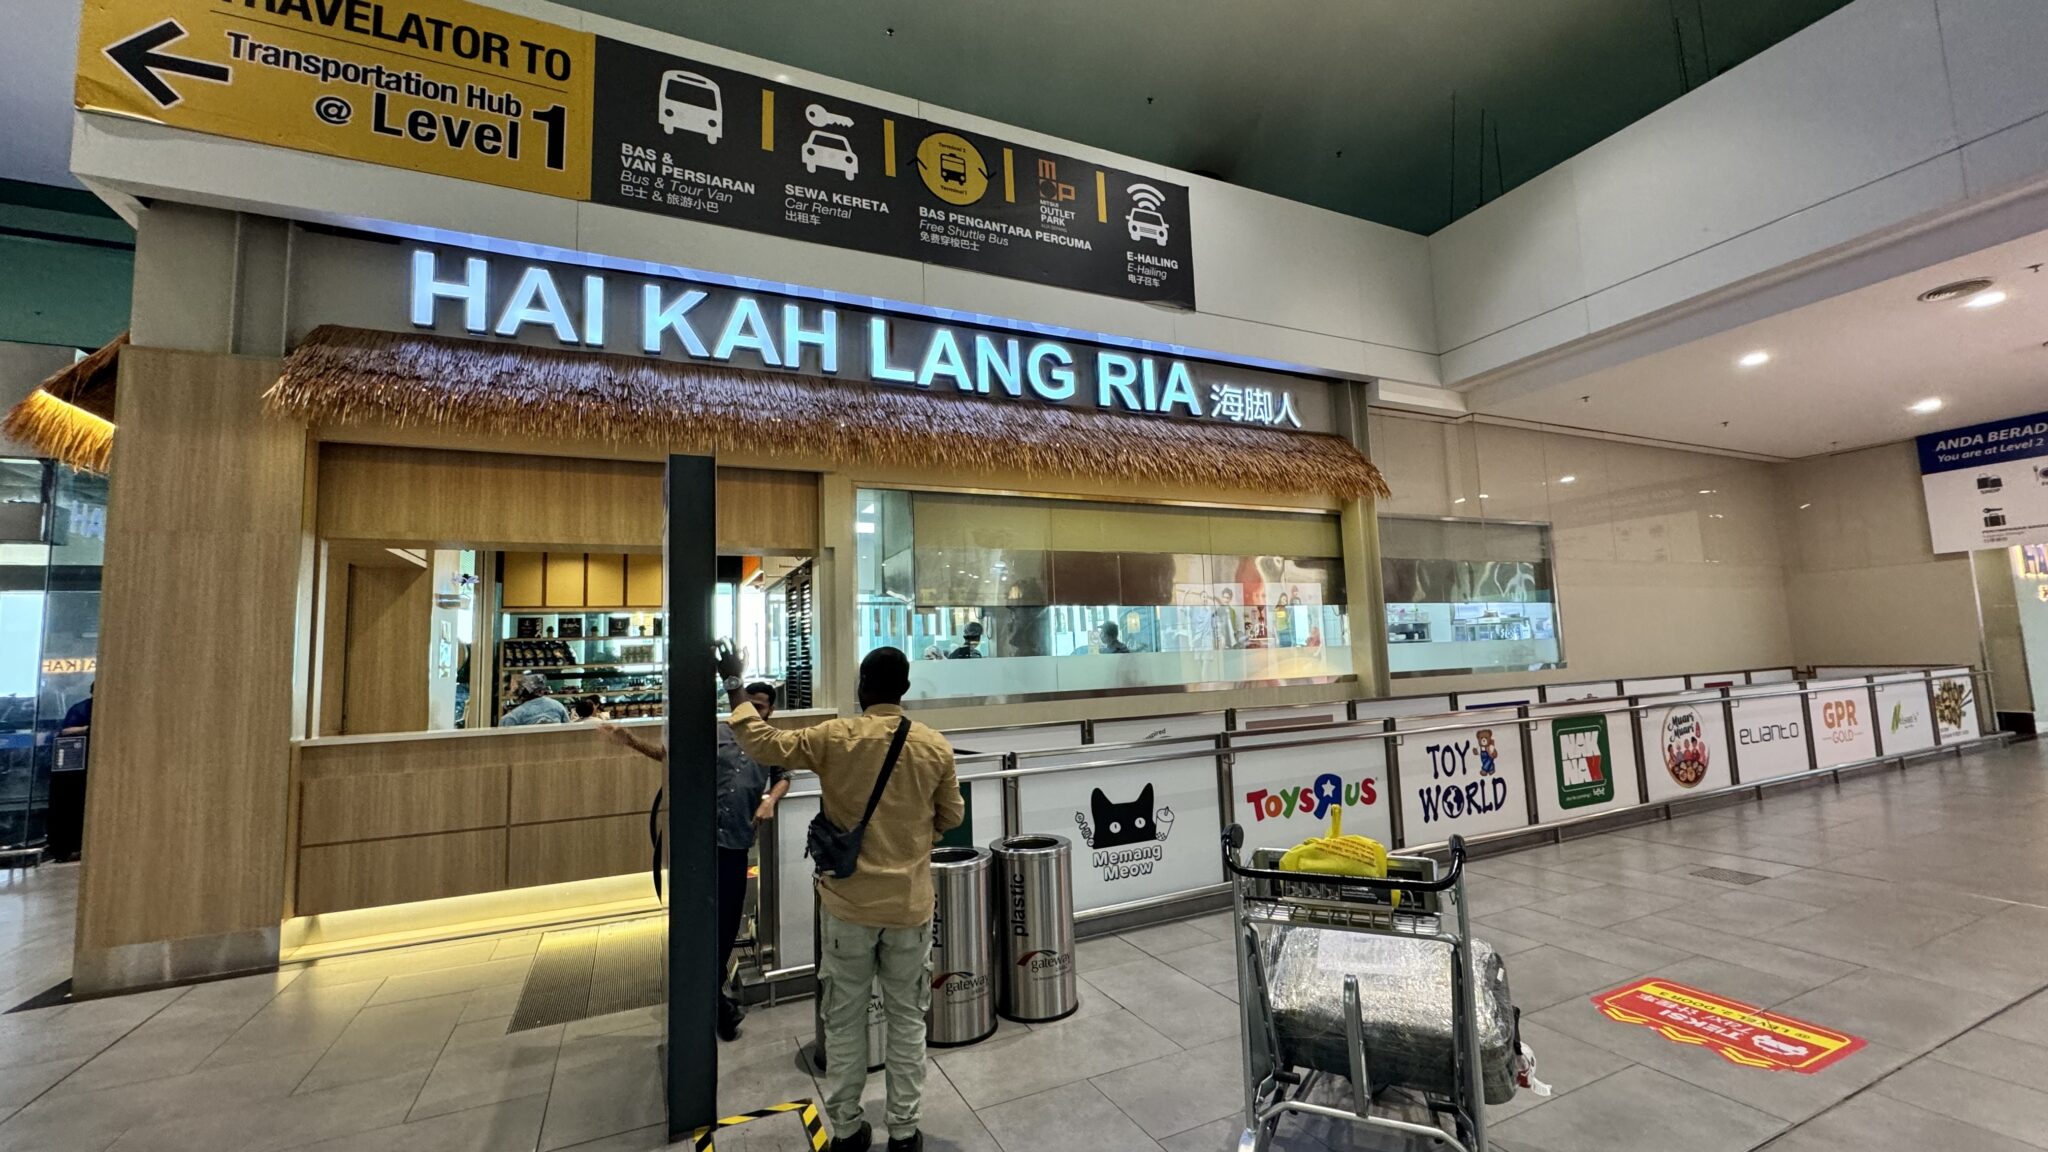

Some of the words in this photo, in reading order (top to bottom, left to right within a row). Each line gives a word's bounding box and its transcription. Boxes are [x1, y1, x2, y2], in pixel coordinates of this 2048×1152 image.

[222, 0, 509, 68] AVELATOR
[520, 40, 571, 81] TO
[226, 32, 458, 104] Transportation
[466, 84, 522, 117] Hub
[315, 96, 351, 125] @
[373, 91, 520, 159] Level
[532, 104, 566, 170] 1
[621, 143, 657, 160] BAS
[662, 153, 674, 165] &
[620, 171, 650, 186] Bus
[654, 177, 665, 190] &
[670, 180, 703, 197] Tour
[708, 187, 733, 203] Van
[621, 156, 656, 174] VAN
[662, 165, 755, 194] PERSIARAN
[621, 184, 648, 200] 巴士
[652, 191, 663, 202] &
[667, 193, 719, 213] 旅游小巴
[785, 184, 828, 202] SEWA
[833, 193, 889, 214] KERETA
[785, 198, 809, 212] Car
[812, 202, 851, 219] Rental
[785, 211, 821, 226] 出租车
[1040, 206, 1075, 221] OUTLET
[1041, 214, 1066, 227] PARK
[919, 206, 946, 221] BAS
[949, 212, 1032, 238] PENGANTARA
[1035, 231, 1092, 250] PERCUMA
[919, 220, 944, 235] Free
[947, 224, 986, 243] Shuttle
[989, 233, 1009, 246] Bus
[1126, 251, 1179, 269] E-HAILING
[1127, 263, 1167, 280] E-Hailing
[411, 248, 605, 348] HAI
[643, 283, 839, 374] KAH
[869, 315, 1076, 402] LANG
[1096, 351, 1203, 417] RIA
[1209, 383, 1303, 429] 海脚人
[1935, 433, 1984, 452] ANDA
[1987, 422, 2048, 442] BERAD
[1938, 453, 1960, 463] You
[1961, 449, 1982, 459] are
[1984, 446, 1997, 455] at
[2000, 438, 2033, 452] Level
[2034, 438, 2045, 447] 2
[1823, 699, 1858, 729] GPR
[1833, 729, 1854, 744] GOLD
[1426, 740, 1470, 779] TOY
[1419, 777, 1507, 823] WORLD
[1093, 845, 1162, 868] Memang
[1103, 861, 1153, 881] Meow
[1010, 873, 1029, 937] plastic
[1031, 952, 1071, 974] gateway
[945, 974, 990, 997] gateway
[1672, 995, 1722, 1014] DOOR
[1658, 1008, 1748, 1042] TEKSI
[1701, 1015, 1755, 1035] Taxi
[1733, 1014, 1790, 1033] LEVEL
